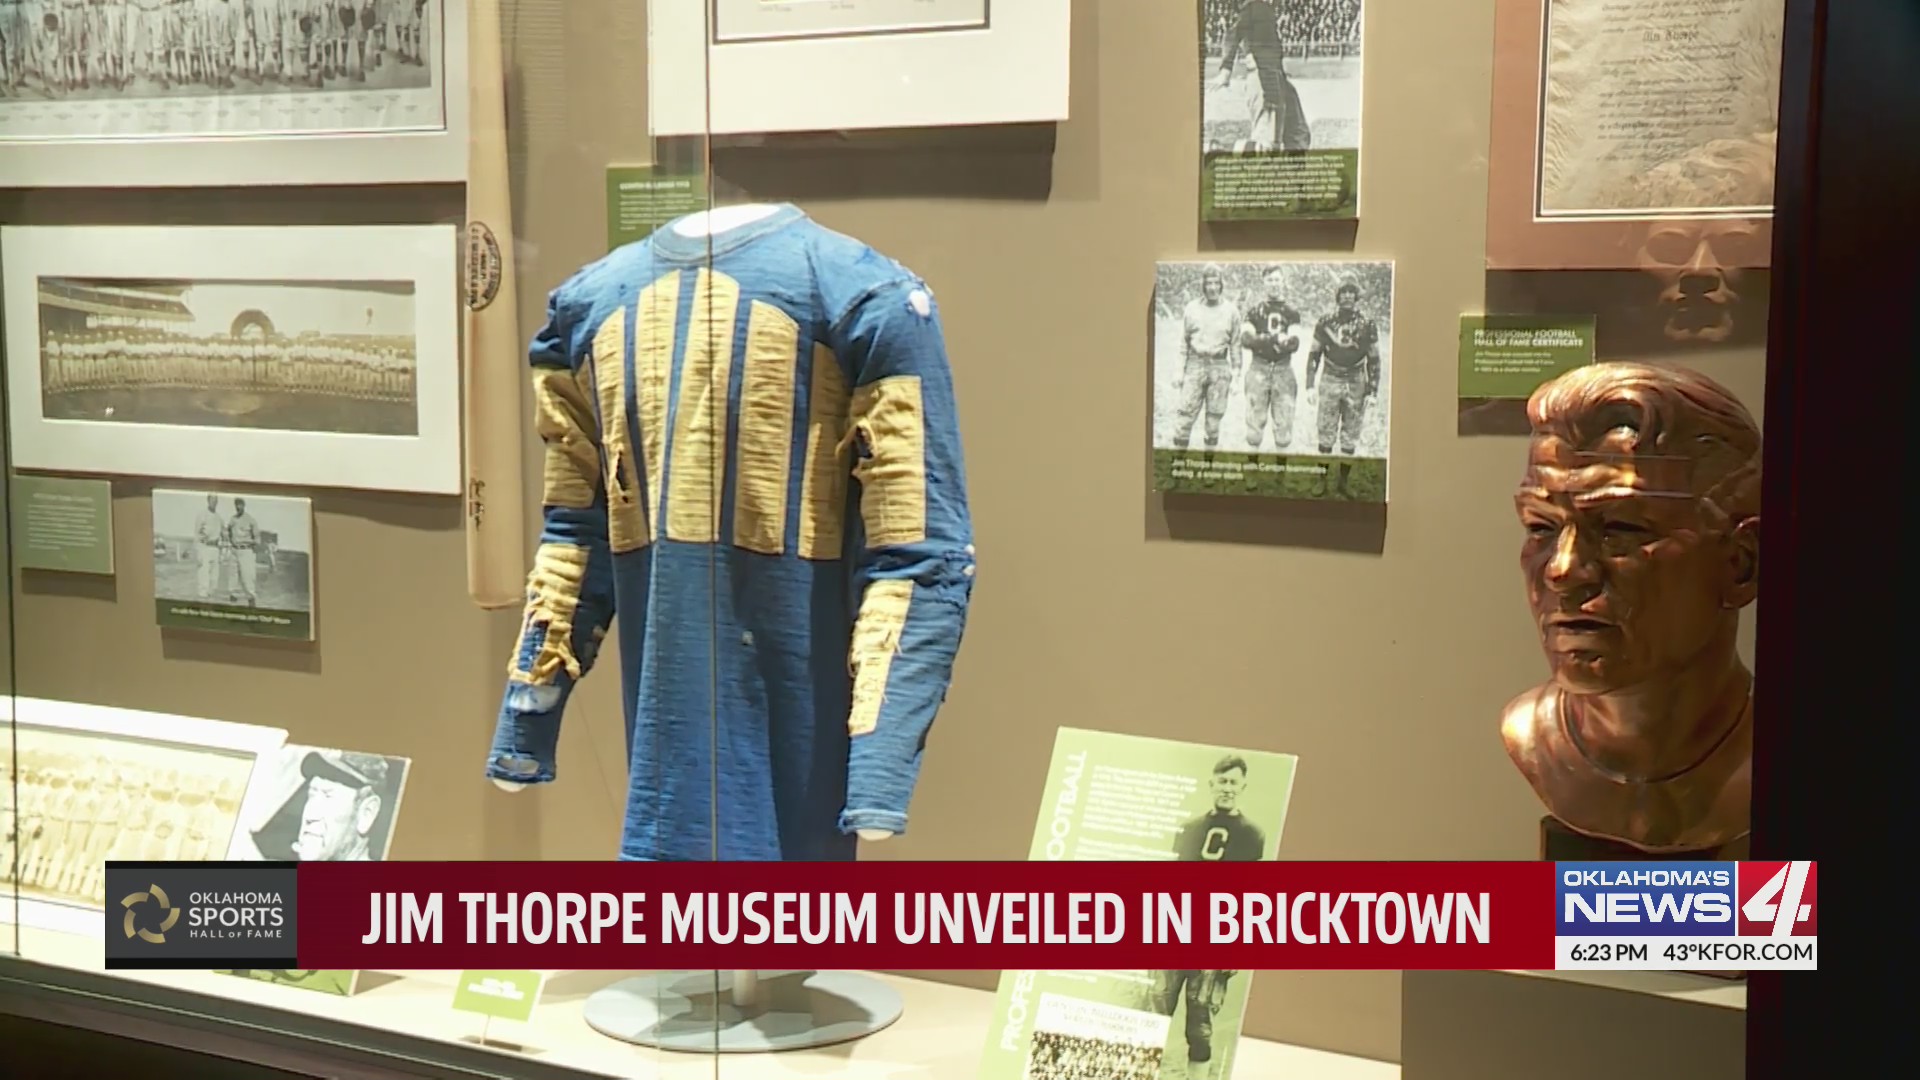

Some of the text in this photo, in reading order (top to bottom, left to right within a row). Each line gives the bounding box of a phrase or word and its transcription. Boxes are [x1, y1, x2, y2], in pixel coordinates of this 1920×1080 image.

[1532, 338, 1584, 347] CERTIFICATE
[1045, 750, 1088, 861] OOTBALL
[1201, 827, 1229, 860] C
